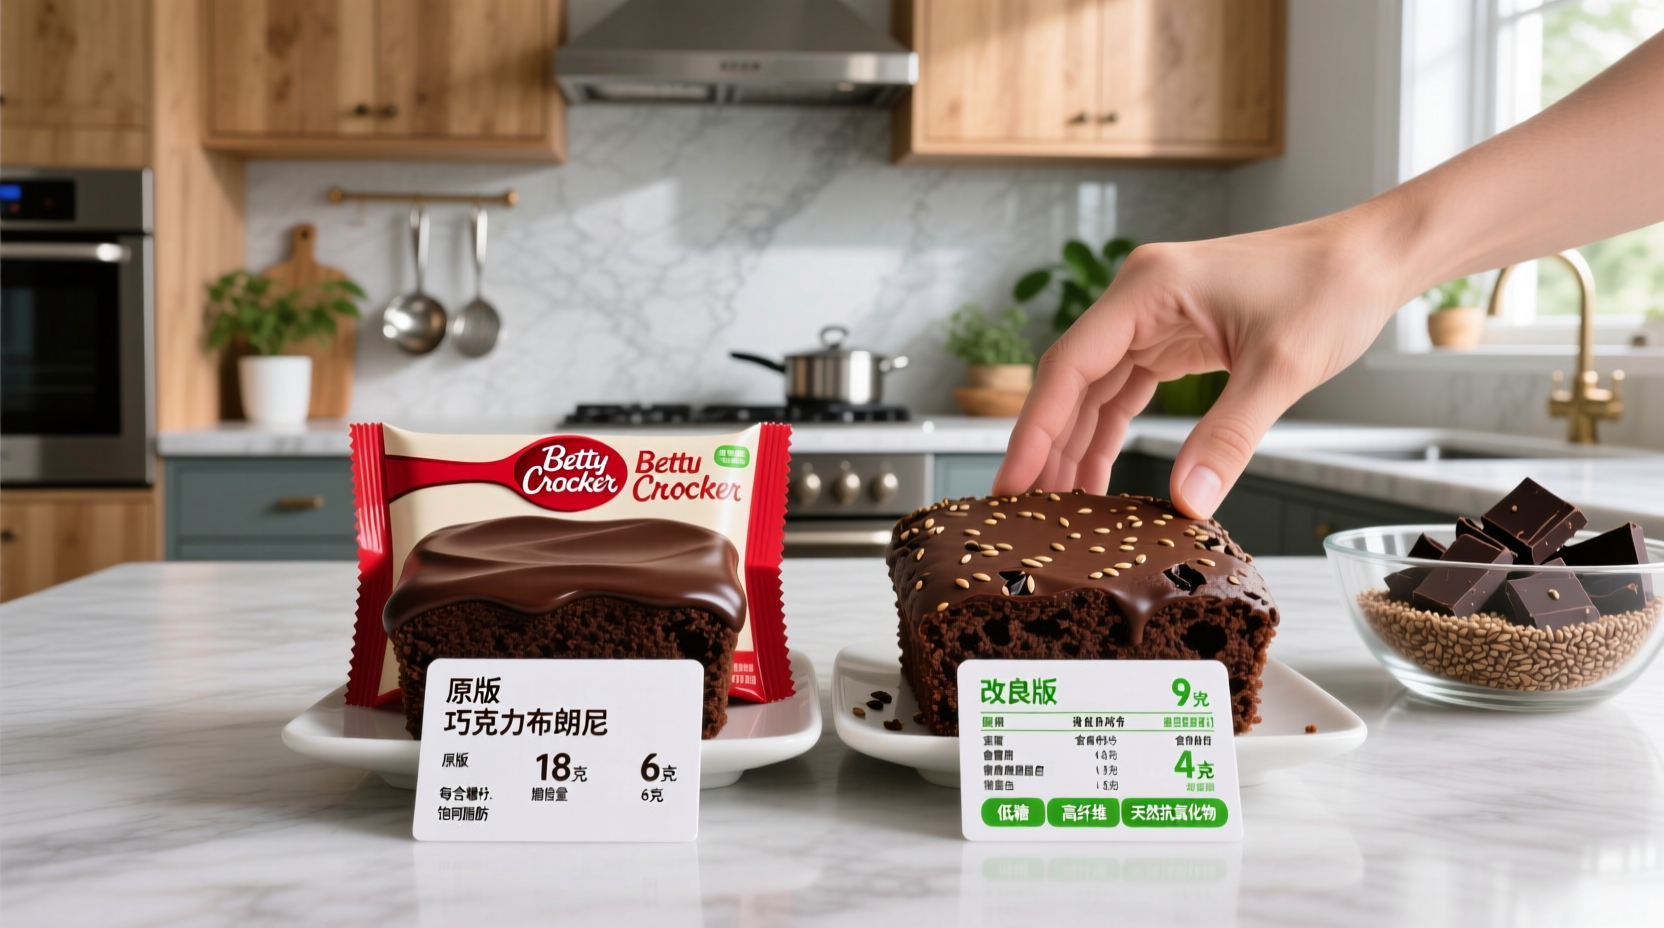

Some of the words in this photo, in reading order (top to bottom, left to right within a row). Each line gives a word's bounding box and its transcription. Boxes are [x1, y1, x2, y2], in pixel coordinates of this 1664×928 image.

[542, 445, 608, 473] Betty
[522, 466, 618, 495] Crocker
[633, 475, 741, 502] Crocker
[446, 676, 501, 704] 原版
[980, 678, 1057, 706] 改良版
[444, 707, 608, 736] 巧克力布朗尼
[536, 752, 588, 782] 18克
[640, 753, 677, 782] 6克
[997, 804, 1030, 822] 低糖
[1062, 804, 1107, 822] 高纤维
